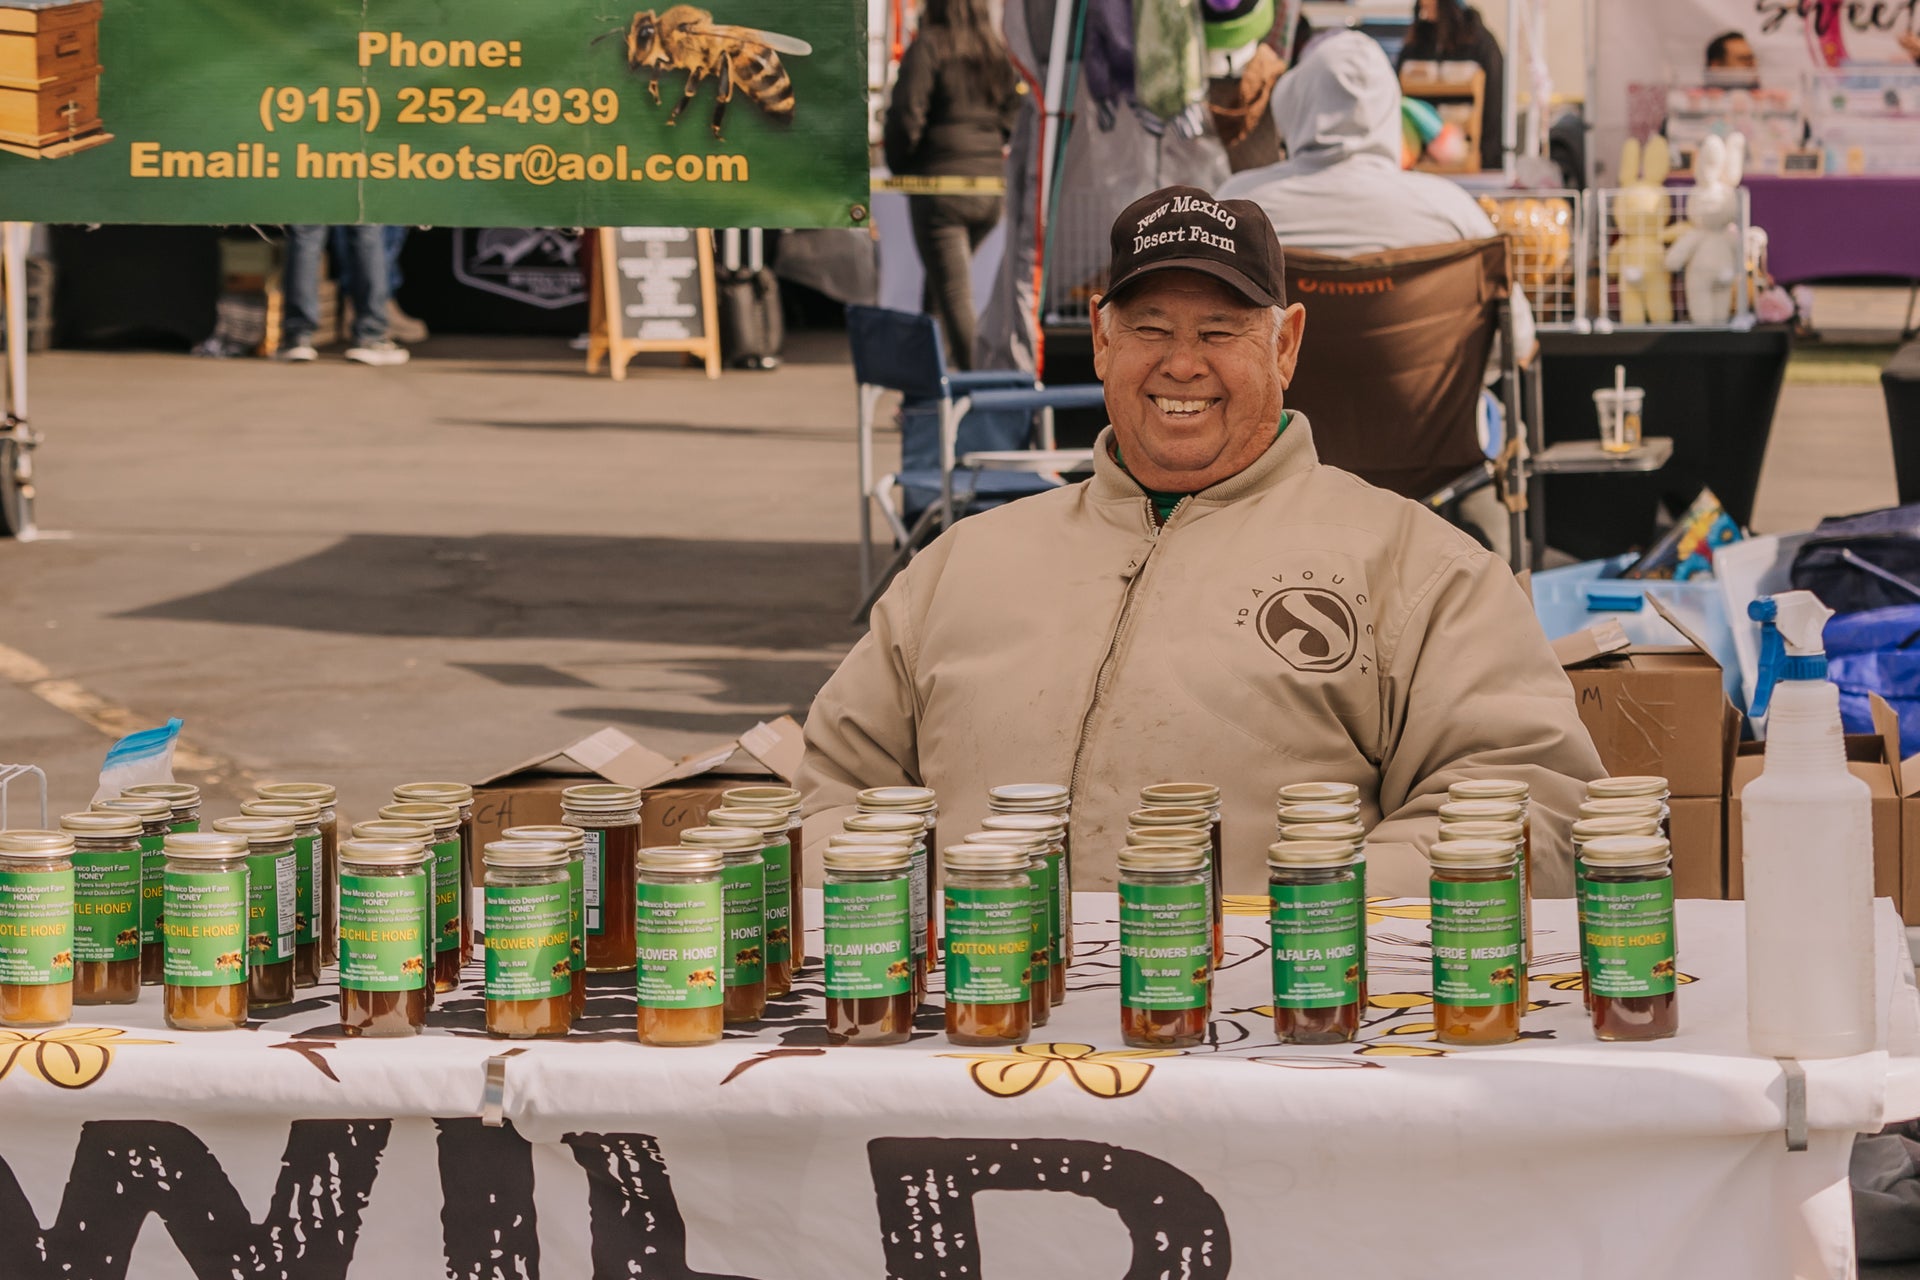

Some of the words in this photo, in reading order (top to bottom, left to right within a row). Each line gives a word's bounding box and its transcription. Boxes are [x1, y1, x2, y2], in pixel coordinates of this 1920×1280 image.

[358, 31, 522, 68] Phone:
[259, 86, 381, 133] (915)
[396, 87, 619, 125] 252-4939
[130, 142, 280, 178] Email:
[296, 143, 749, 185] hmskotsr@aol.com
[1137, 203, 1169, 234] New
[1171, 196, 1236, 230] Mexico
[1133, 226, 1185, 254] Desert
[1188, 226, 1236, 254] Farm
[177, 893, 202, 901] HONEY
[95, 903, 132, 915] HONEY
[509, 905, 536, 913] HONEY
[1307, 909, 1335, 917] HONEY
[1452, 908, 1480, 916] HONEY
[1608, 903, 1635, 911] HONEY
[30, 924, 67, 937] HONEY
[170, 925, 199, 938] CHILE
[202, 923, 240, 938] HONEY
[348, 929, 378, 942] CHILE
[381, 928, 418, 942] HONEY
[731, 926, 762, 940] HONEY
[1629, 931, 1667, 947] HONEY
[683, 946, 718, 960] HONEY
[833, 943, 862, 956] CLAW
[865, 940, 901, 955] HONEY
[951, 942, 996, 955] COTTON
[1139, 946, 1188, 958] FLOWERS
[1276, 949, 1323, 962] ALFALFA
[1162, 968, 1181, 977] RAW
